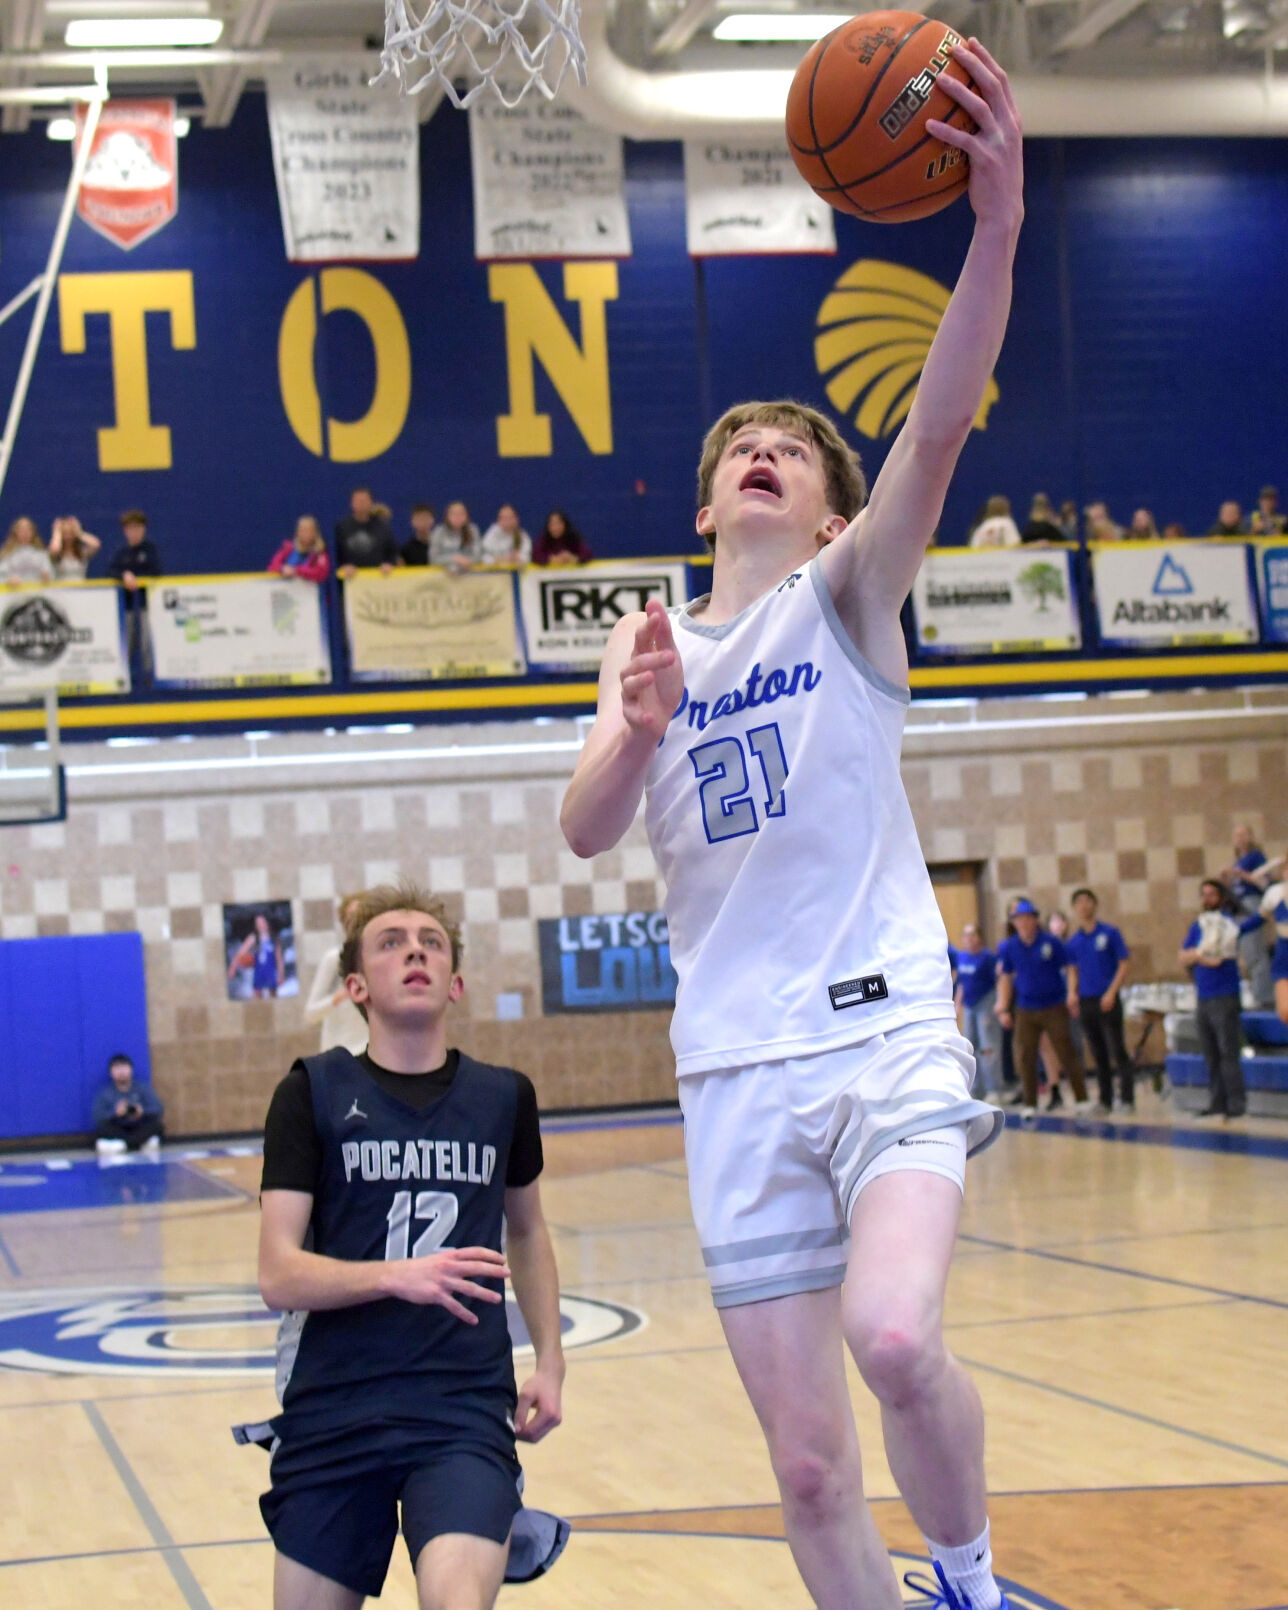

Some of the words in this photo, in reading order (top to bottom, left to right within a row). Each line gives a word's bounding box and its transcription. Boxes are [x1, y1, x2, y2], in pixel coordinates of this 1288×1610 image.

[882, 90, 927, 136] PRO
[552, 584, 661, 621] RKT
[1113, 596, 1230, 625] Altabank
[687, 721, 790, 845] 21
[868, 981, 879, 993] M
[341, 1138, 497, 1186] POCATELLO
[384, 1190, 459, 1261] 12
